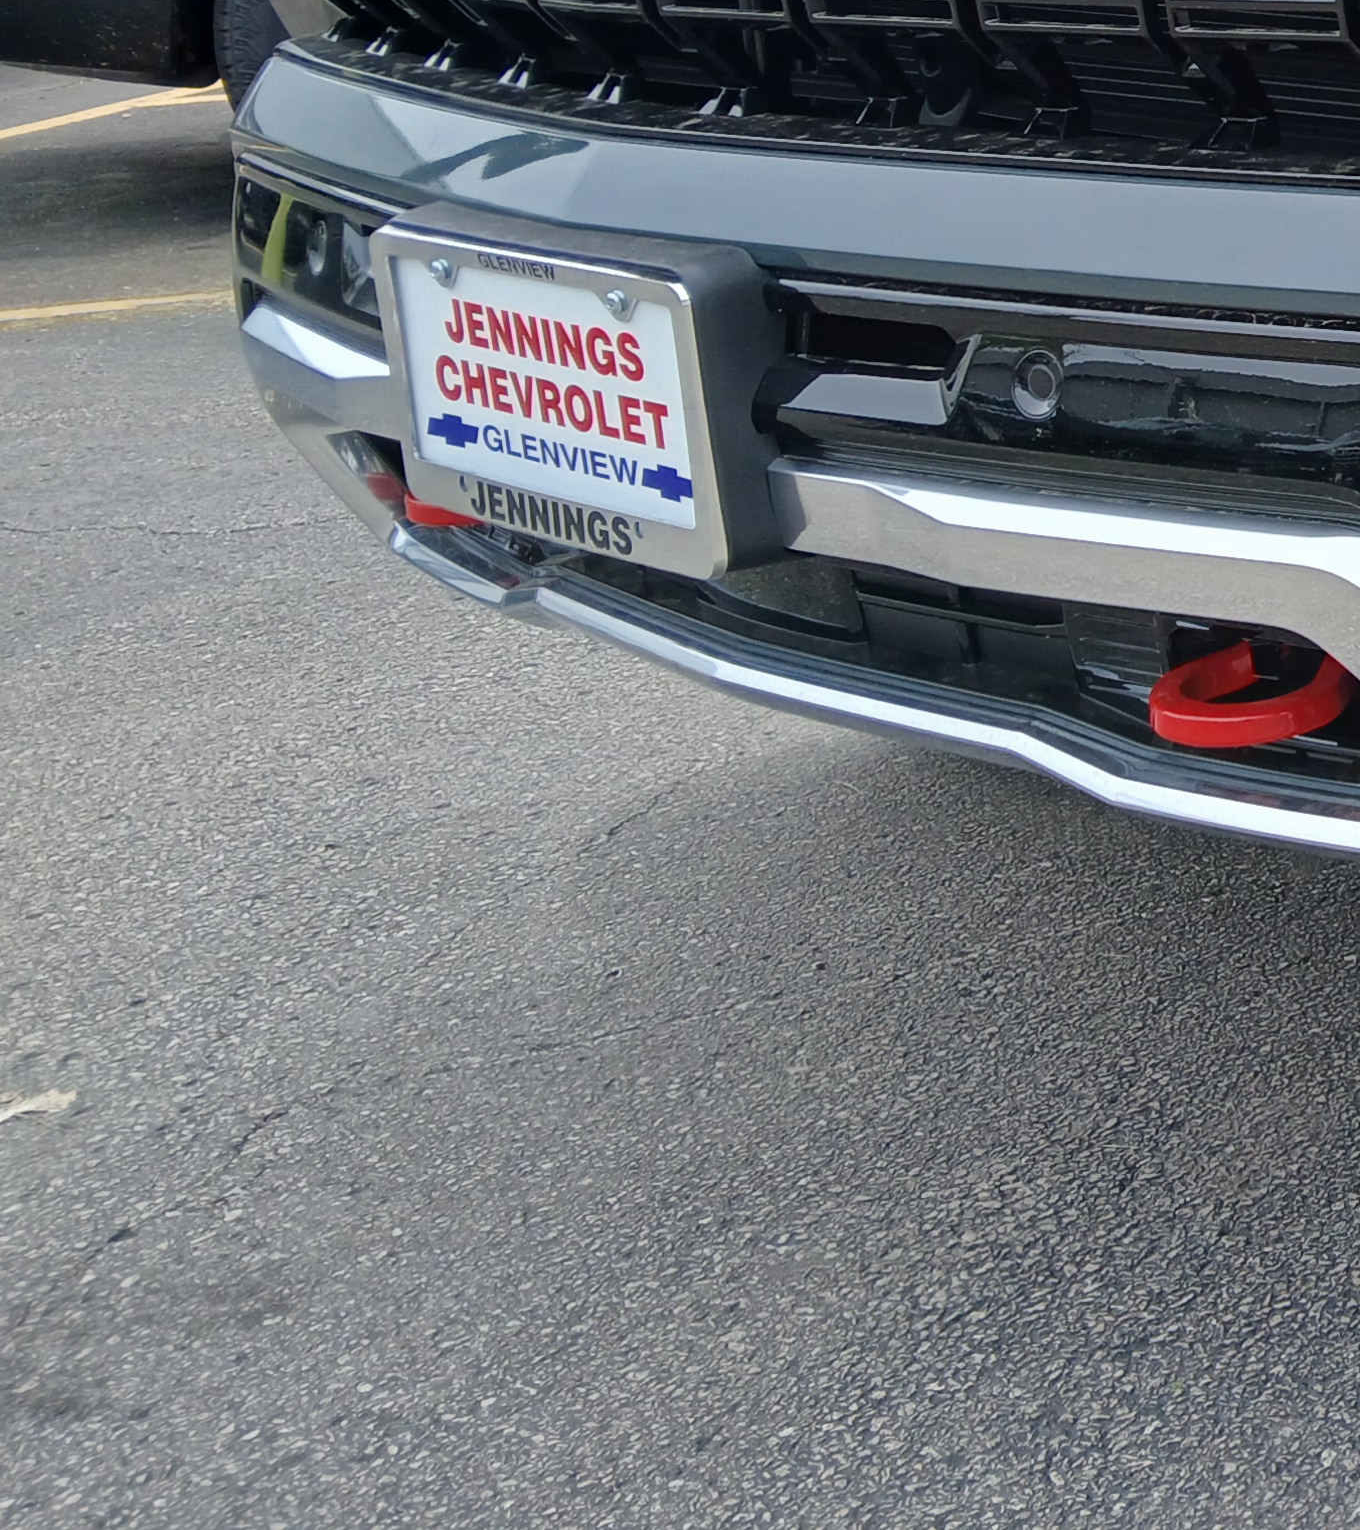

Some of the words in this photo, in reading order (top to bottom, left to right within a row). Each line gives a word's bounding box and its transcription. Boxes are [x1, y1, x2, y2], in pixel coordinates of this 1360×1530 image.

[476, 252, 556, 282] GLENVIEW
[445, 297, 645, 382] JENNINGS
[435, 355, 670, 450] CHEVROLET
[482, 425, 638, 486] GLENVIEW
